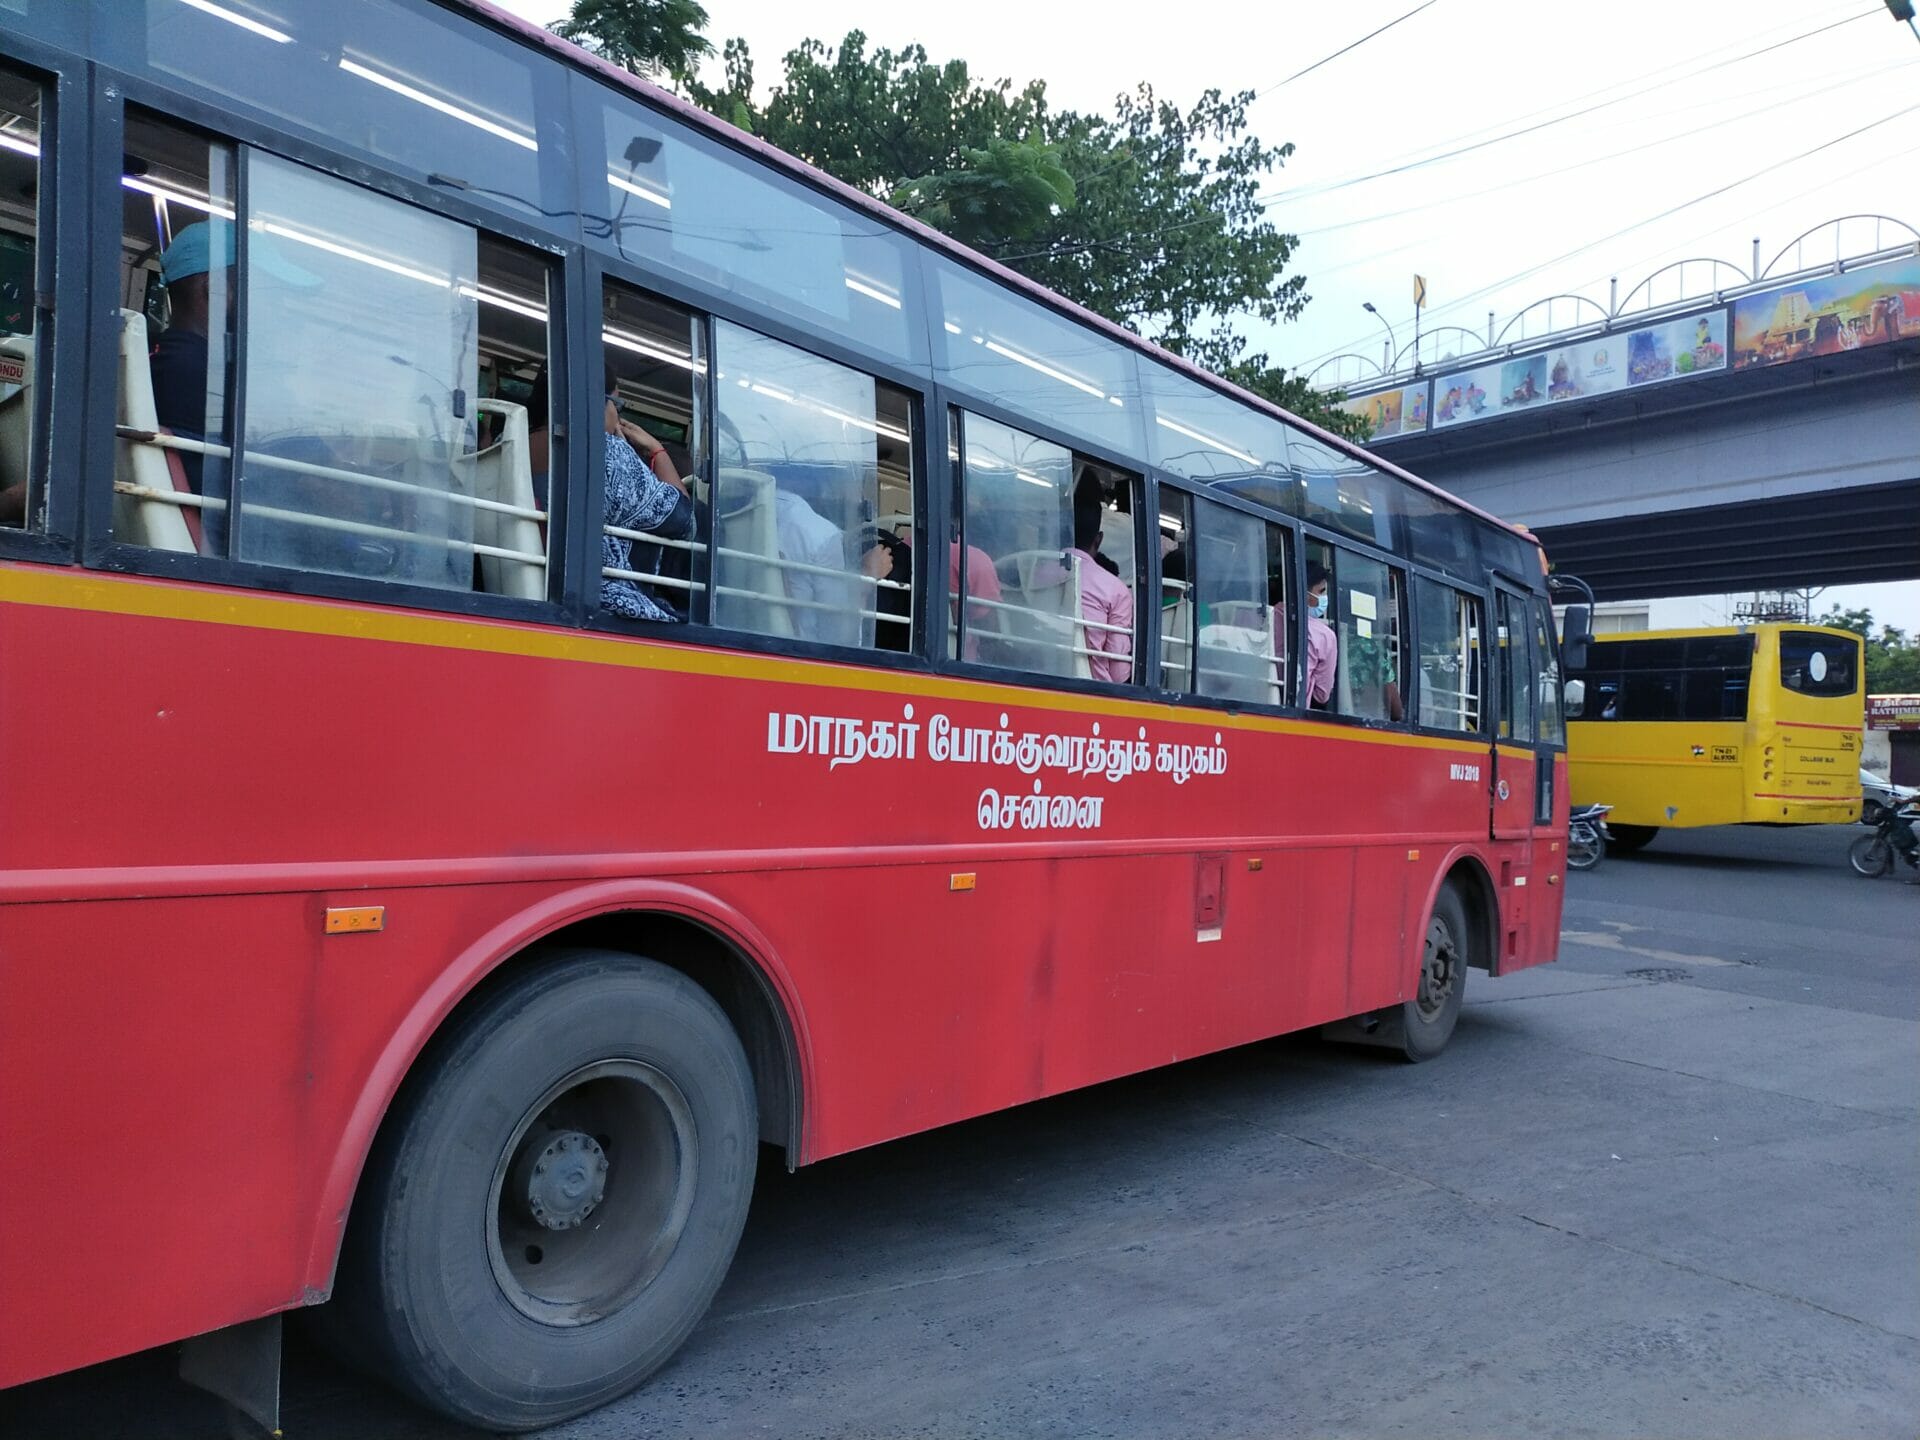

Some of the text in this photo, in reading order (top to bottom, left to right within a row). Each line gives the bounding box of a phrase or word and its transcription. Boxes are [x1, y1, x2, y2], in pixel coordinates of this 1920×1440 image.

[767, 703, 1227, 785] மாநகர் போக்குவரத்துக் கழகம்
[977, 778, 1104, 830] சென்னை
